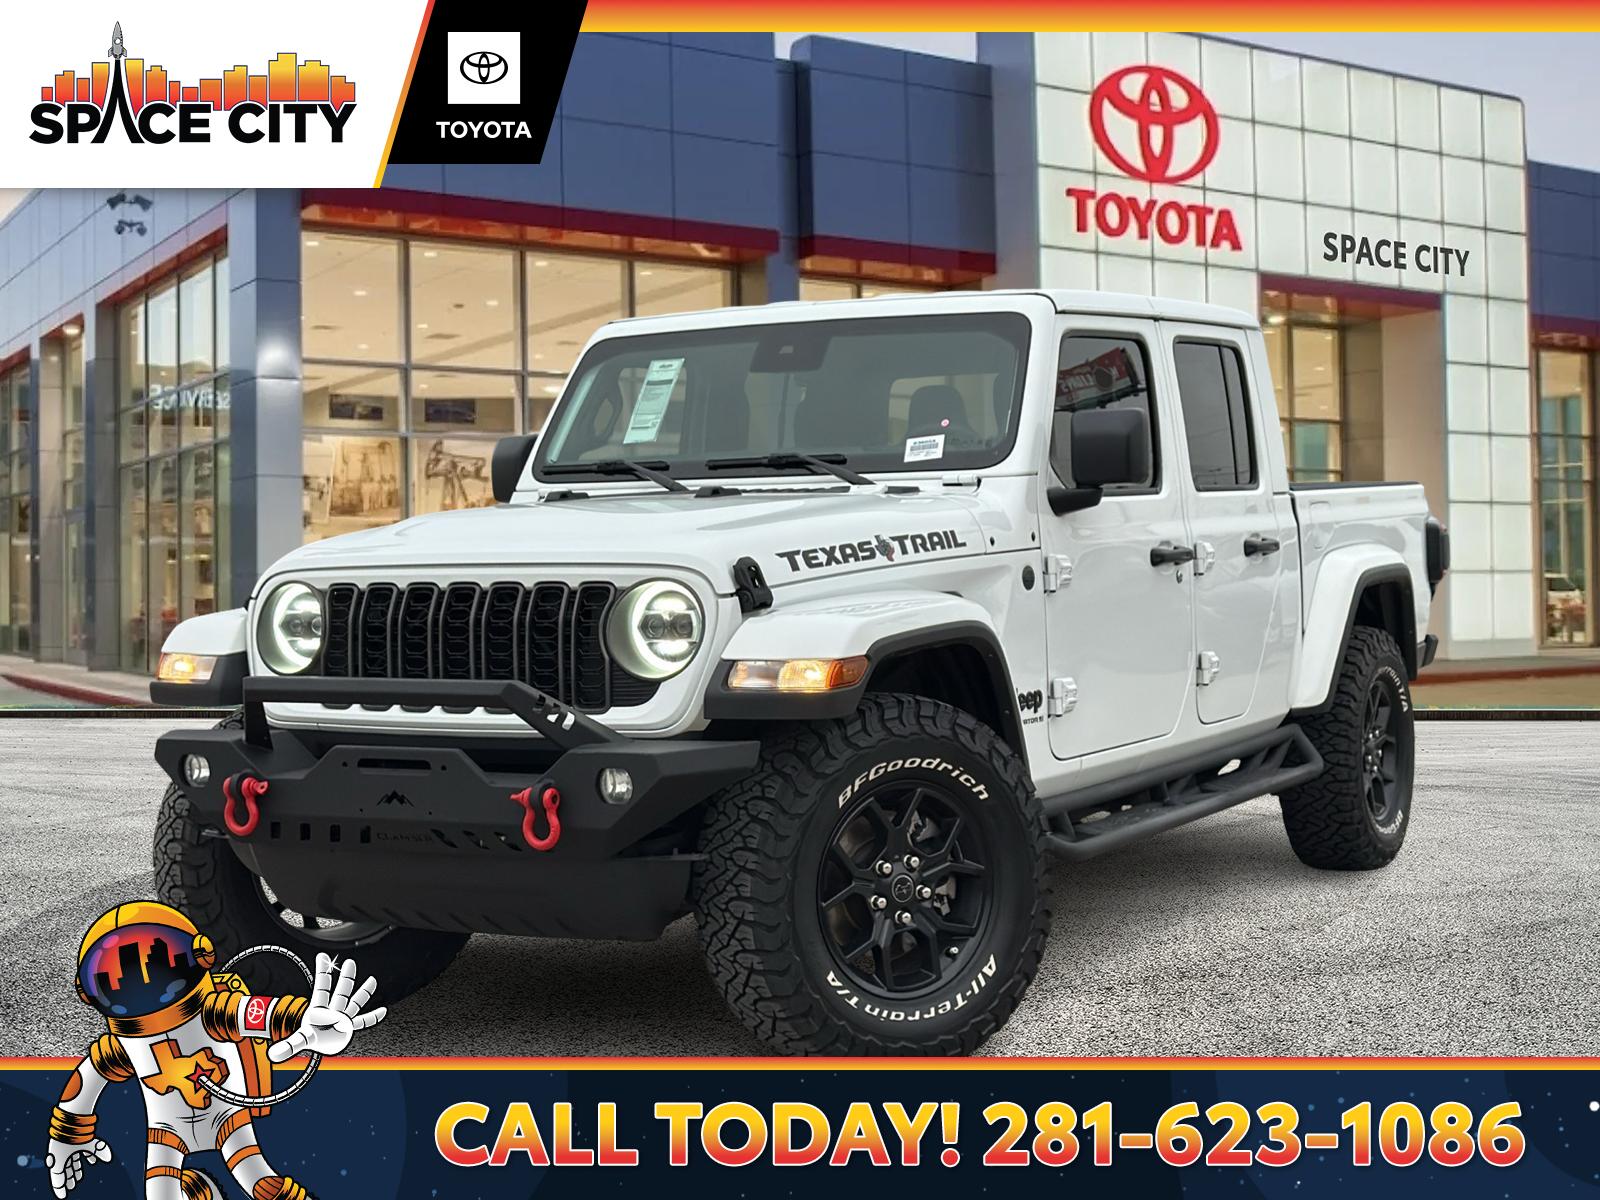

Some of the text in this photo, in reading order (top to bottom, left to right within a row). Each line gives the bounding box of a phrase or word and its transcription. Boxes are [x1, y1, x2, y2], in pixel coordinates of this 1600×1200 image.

[1065, 188, 1242, 251] TOYOTA
[1323, 232, 1470, 277] SPACE CITY
[775, 530, 967, 573] TEXAS TRAIL
[1016, 688, 1043, 714] eep
[838, 757, 990, 809] BFGoodrich
[826, 953, 998, 1022] All-Terrain T/A
